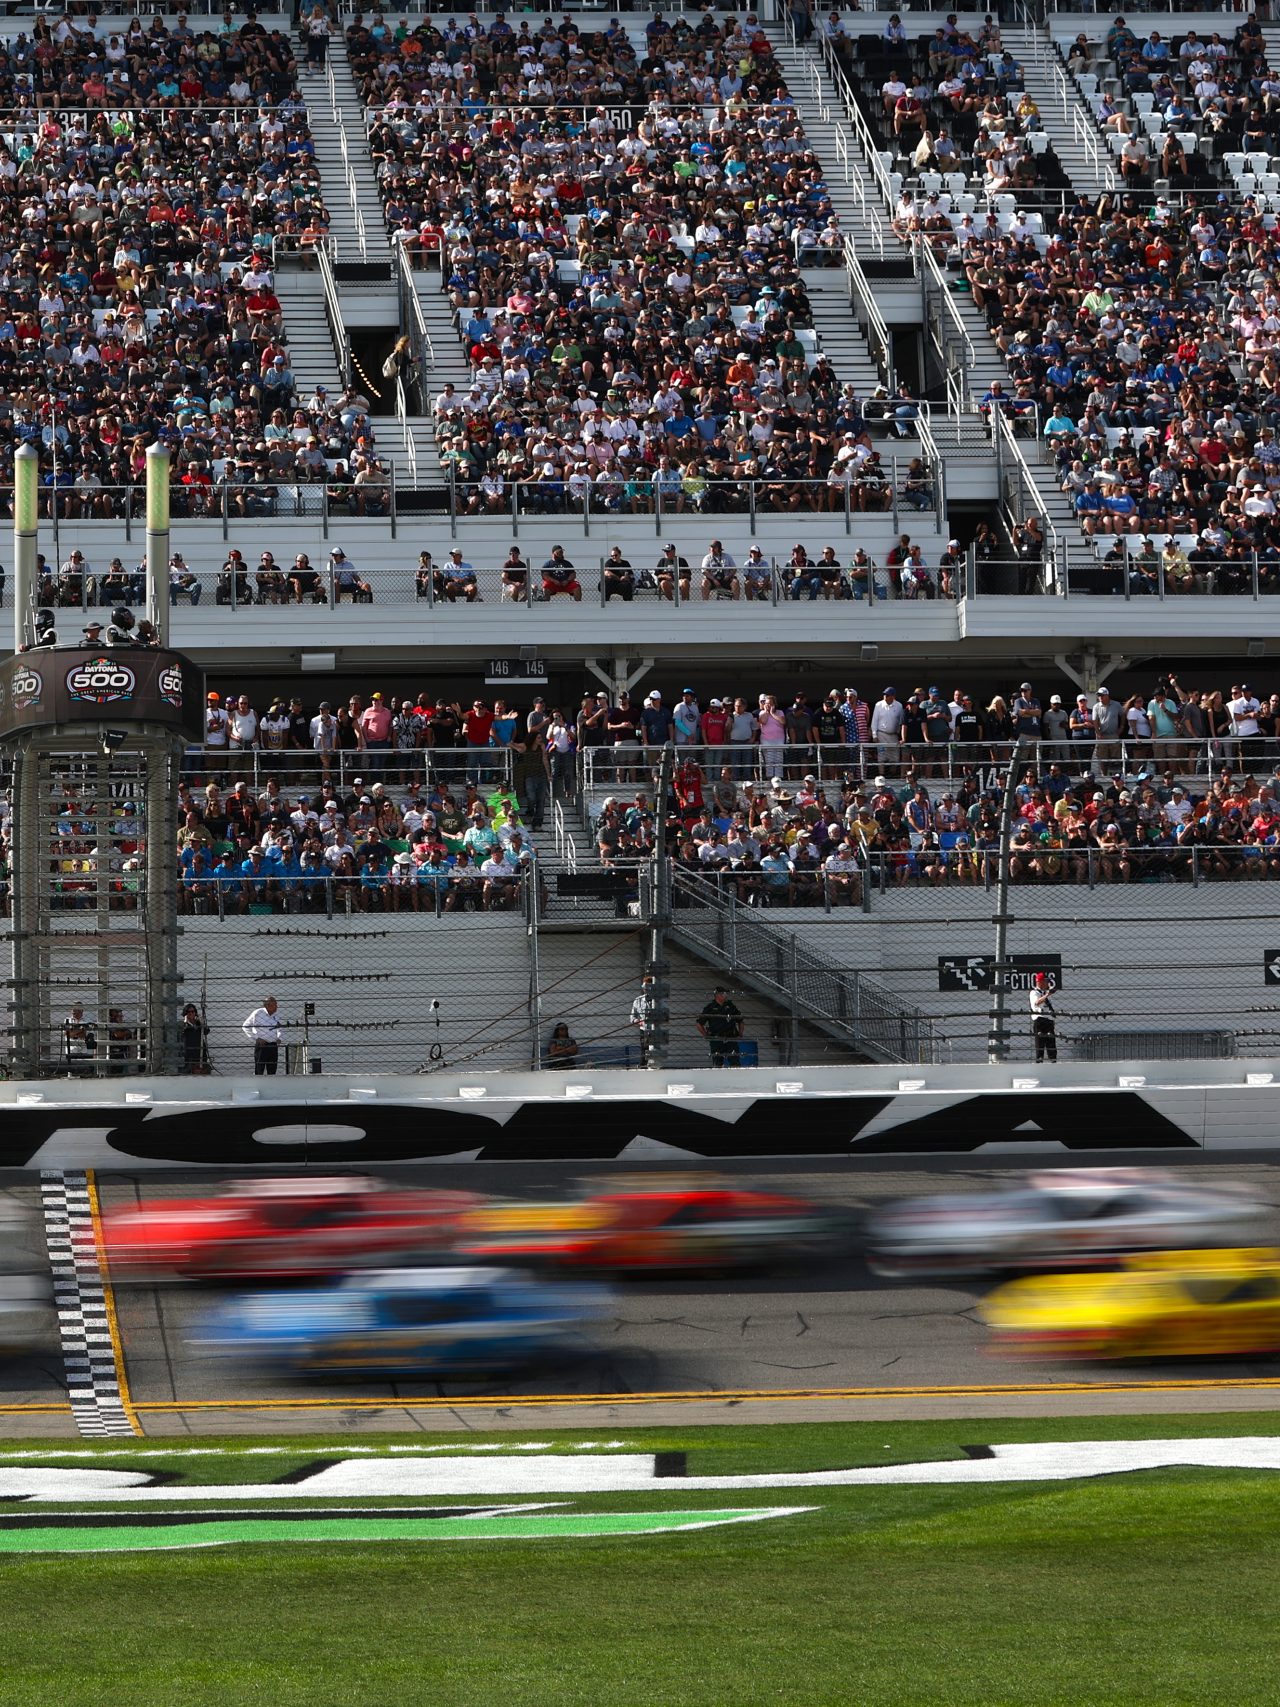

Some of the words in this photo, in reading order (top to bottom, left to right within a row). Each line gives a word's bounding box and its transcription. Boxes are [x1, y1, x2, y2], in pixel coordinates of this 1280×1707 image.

[490, 661, 509, 675] 146
[526, 661, 544, 675] 145
[73, 673, 129, 688] 500
[163, 676, 183, 693] 50
